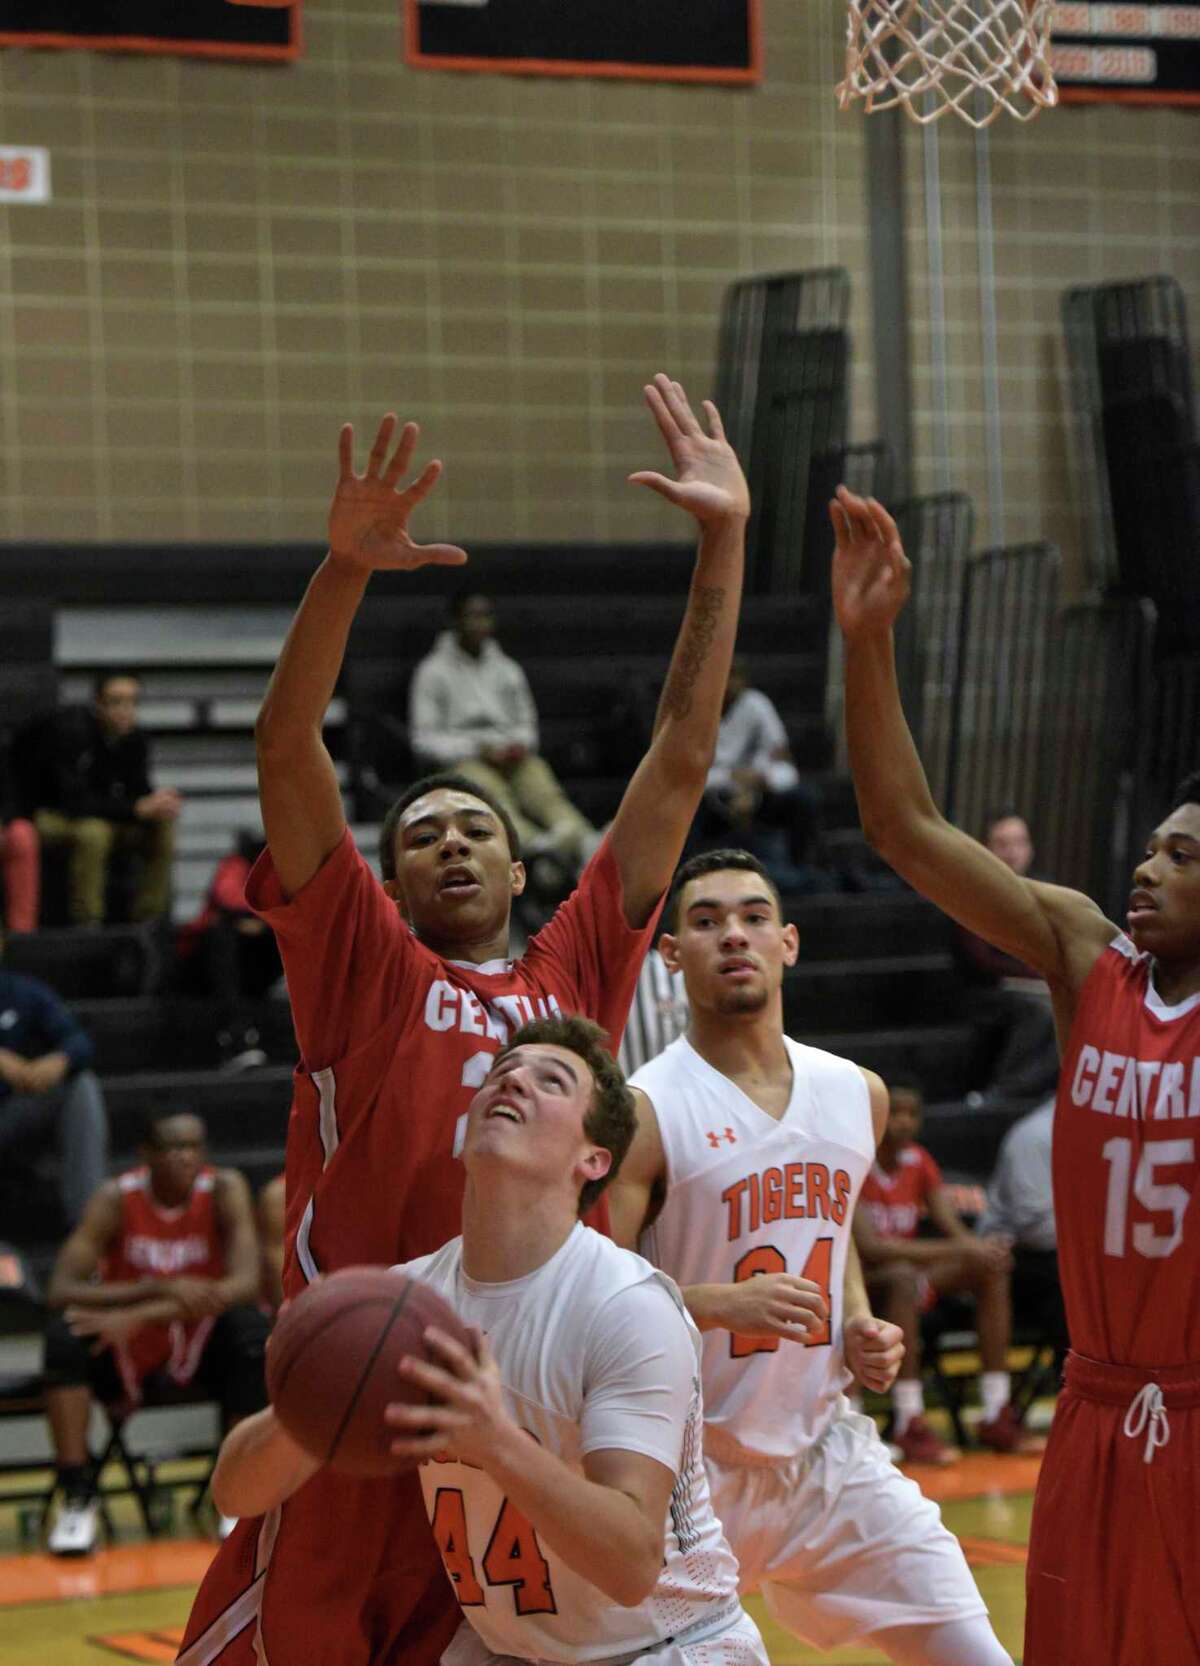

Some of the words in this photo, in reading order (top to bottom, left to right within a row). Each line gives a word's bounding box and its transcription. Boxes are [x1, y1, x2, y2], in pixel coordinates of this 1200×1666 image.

[721, 1162, 851, 1242] TIGERS
[1102, 1136, 1195, 1259] 15
[431, 1486, 559, 1617] 44
